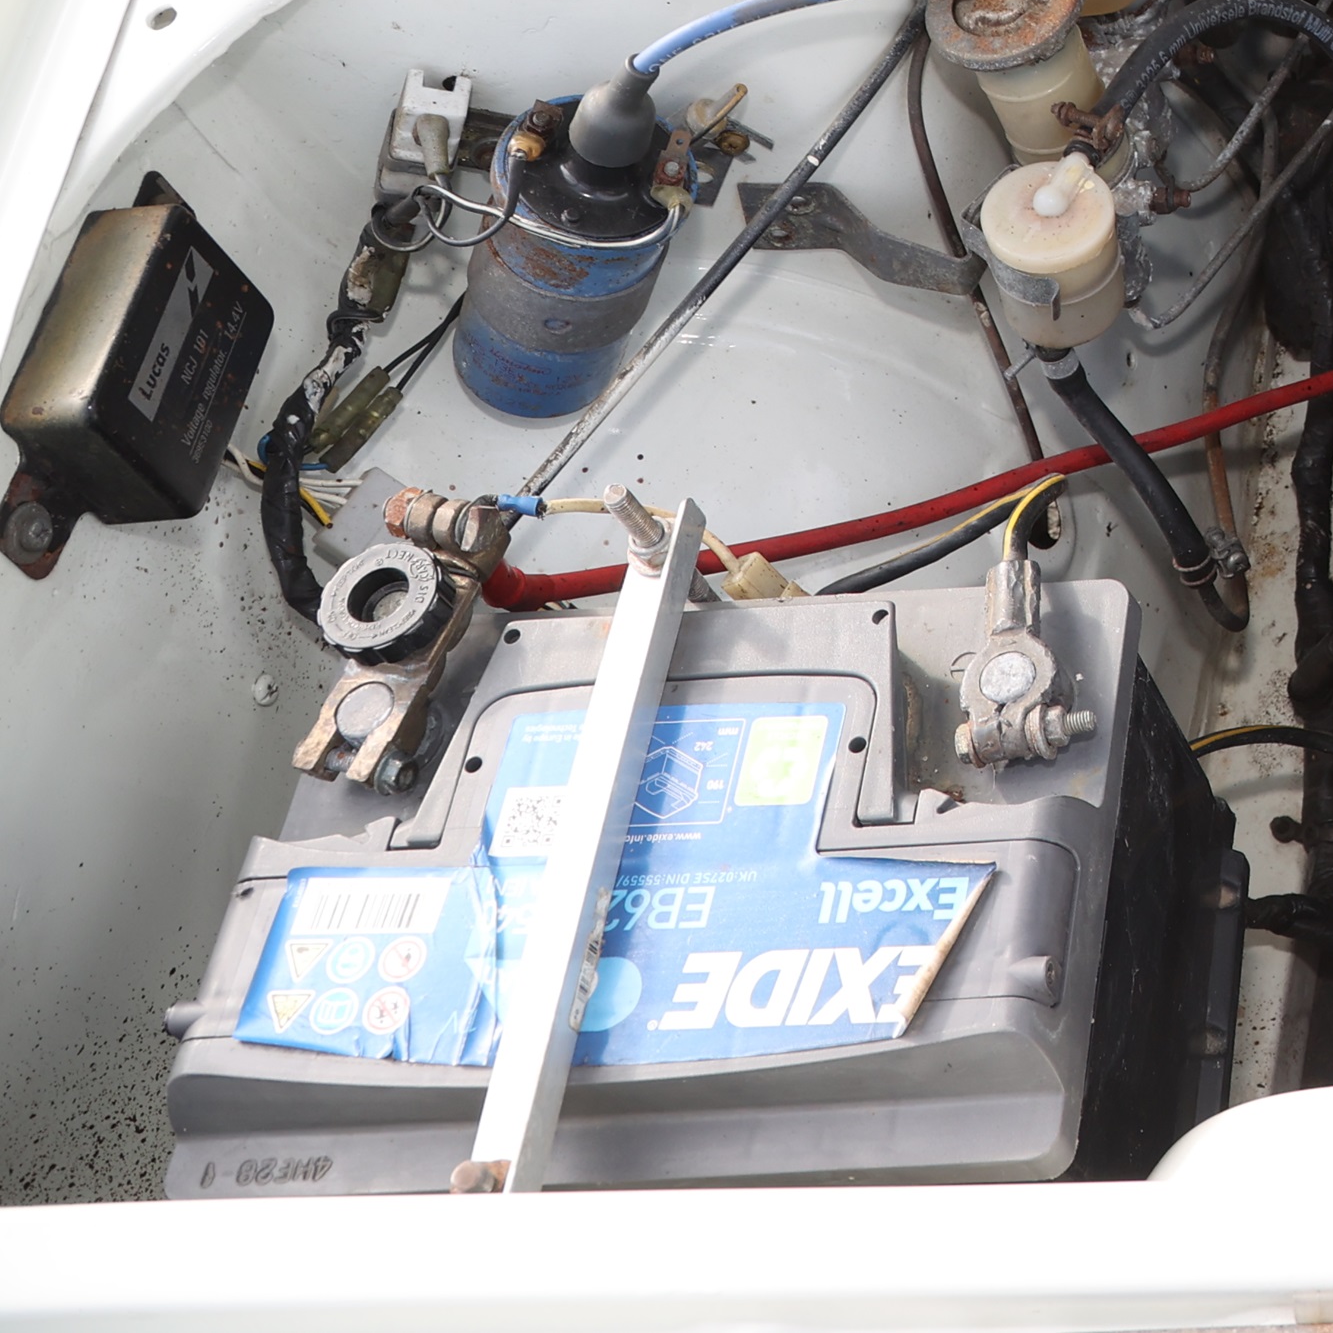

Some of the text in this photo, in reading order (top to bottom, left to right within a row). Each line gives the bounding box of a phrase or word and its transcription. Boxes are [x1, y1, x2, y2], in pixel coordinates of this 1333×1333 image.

[139, 342, 171, 402] Lucas
[181, 329, 208, 387] NCJ 101
[181, 401, 206, 447] Voltage
[224, 301, 246, 342] 14.4V
[694, 741, 714, 752] 242
[718, 726, 740, 736] mm
[706, 779, 725, 790] 190
[693, 870, 758, 883] UK:027SE
[818, 876, 970, 924] Excell
[657, 944, 938, 1032] EXIDE
